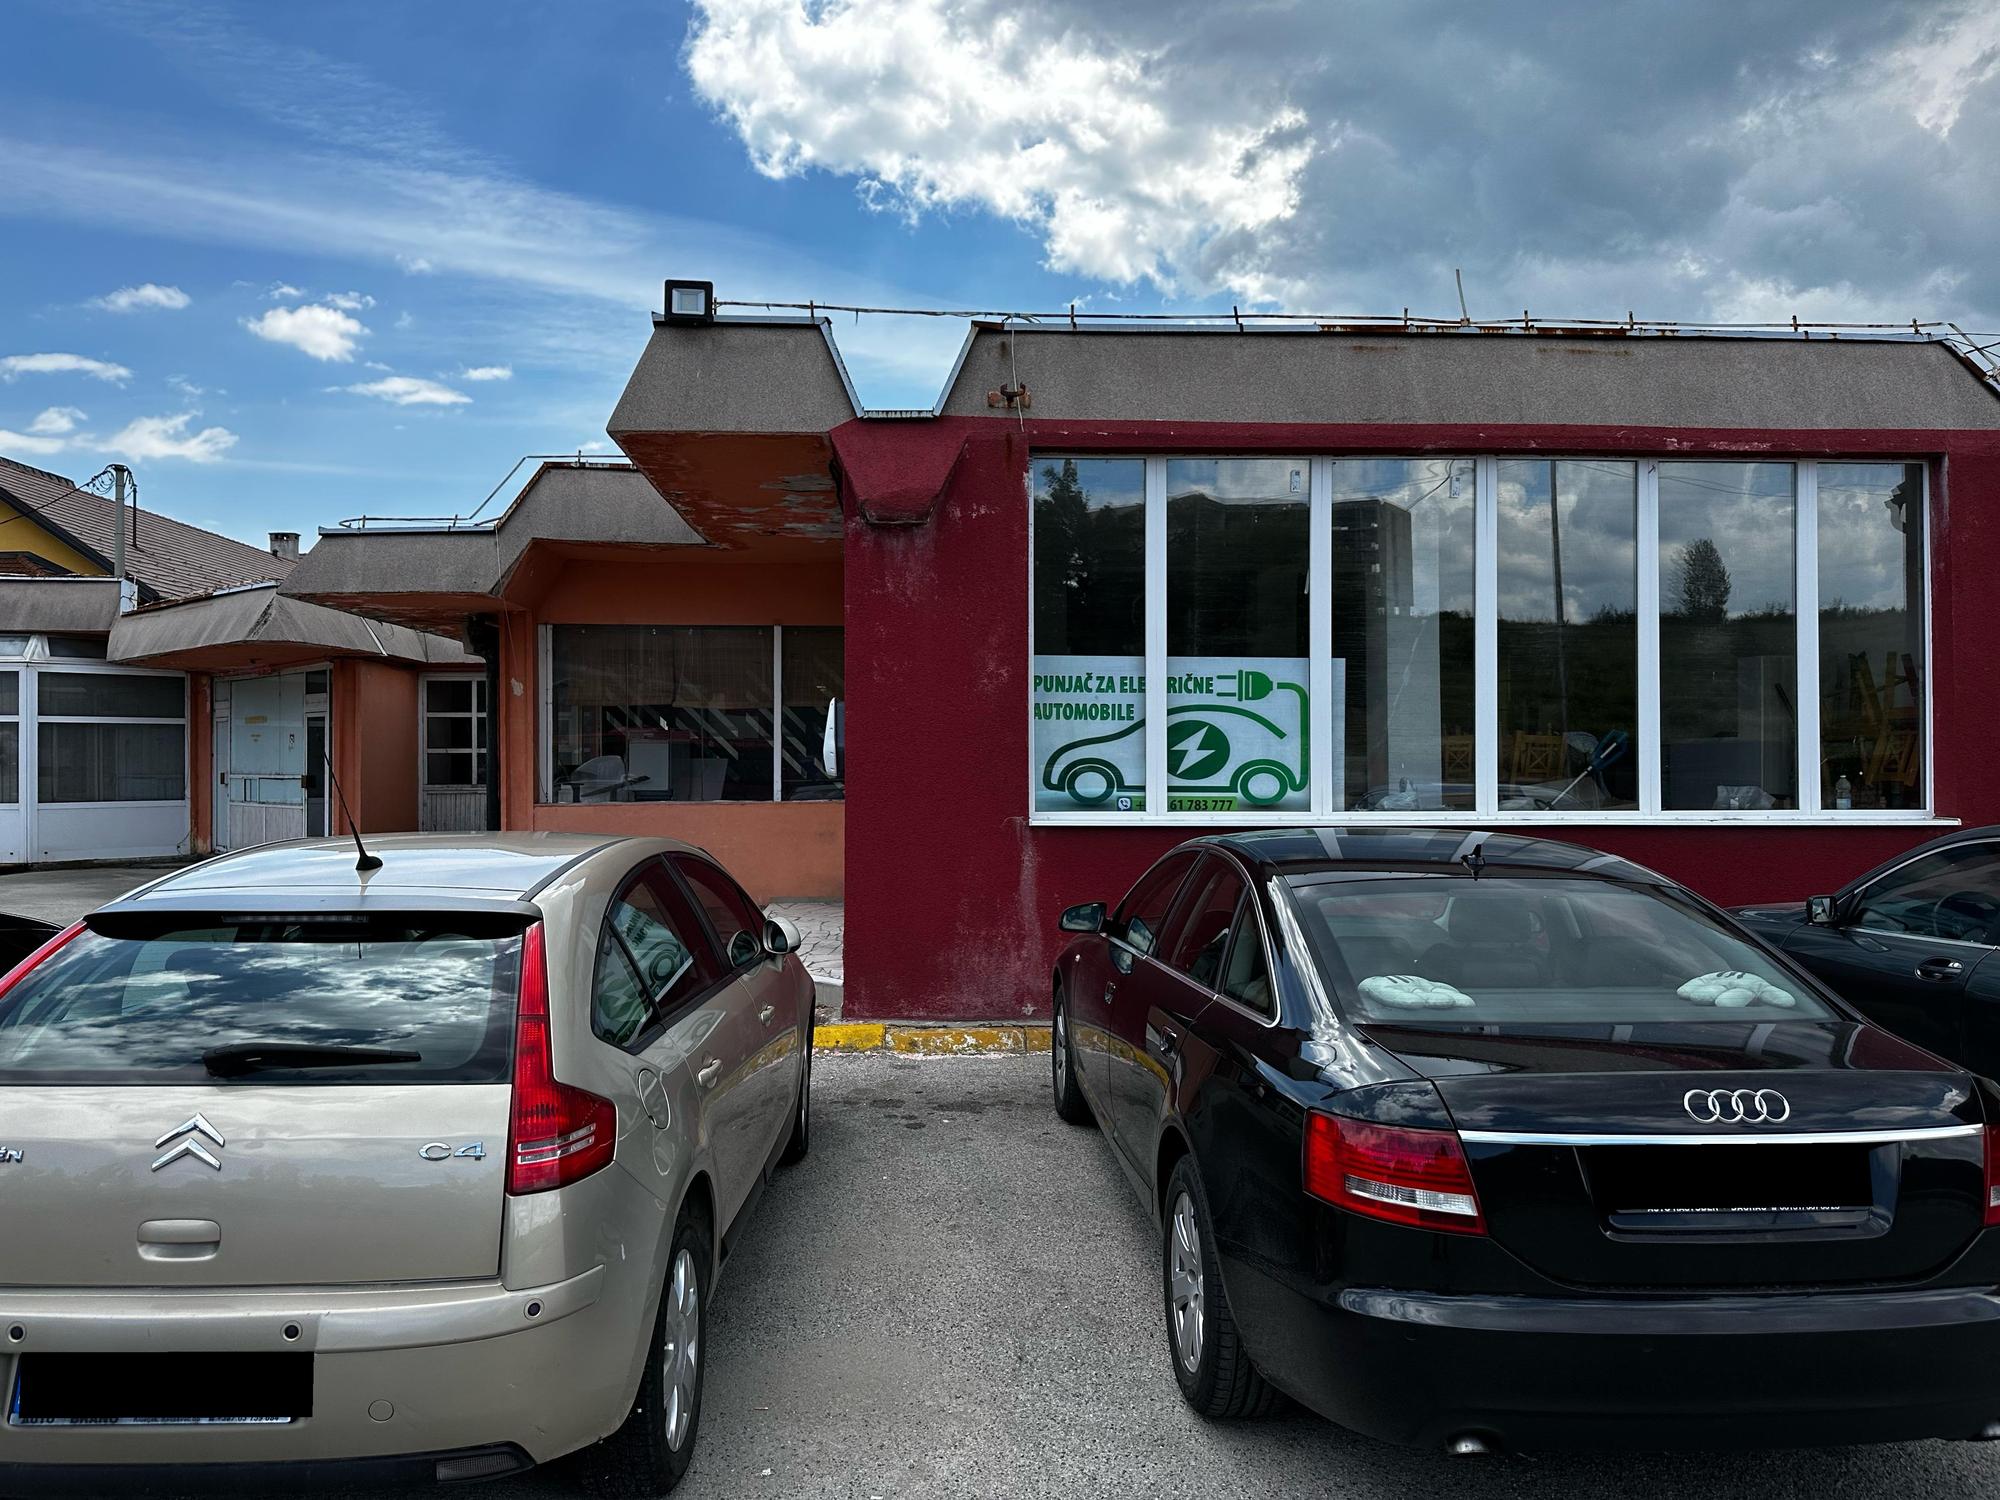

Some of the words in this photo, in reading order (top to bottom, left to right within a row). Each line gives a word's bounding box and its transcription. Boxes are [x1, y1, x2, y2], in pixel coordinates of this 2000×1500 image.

[1034, 673, 1093, 693] PUNJAČ
[1096, 676, 1116, 694] ZA
[1120, 673, 1214, 694] ELERIČNE
[1034, 703, 1135, 721] AUTOMOBILE
[1170, 800, 1184, 812] 61
[1187, 800, 1209, 812] 783
[1211, 800, 1233, 812] 777
[418, 1142, 486, 1161] C4
